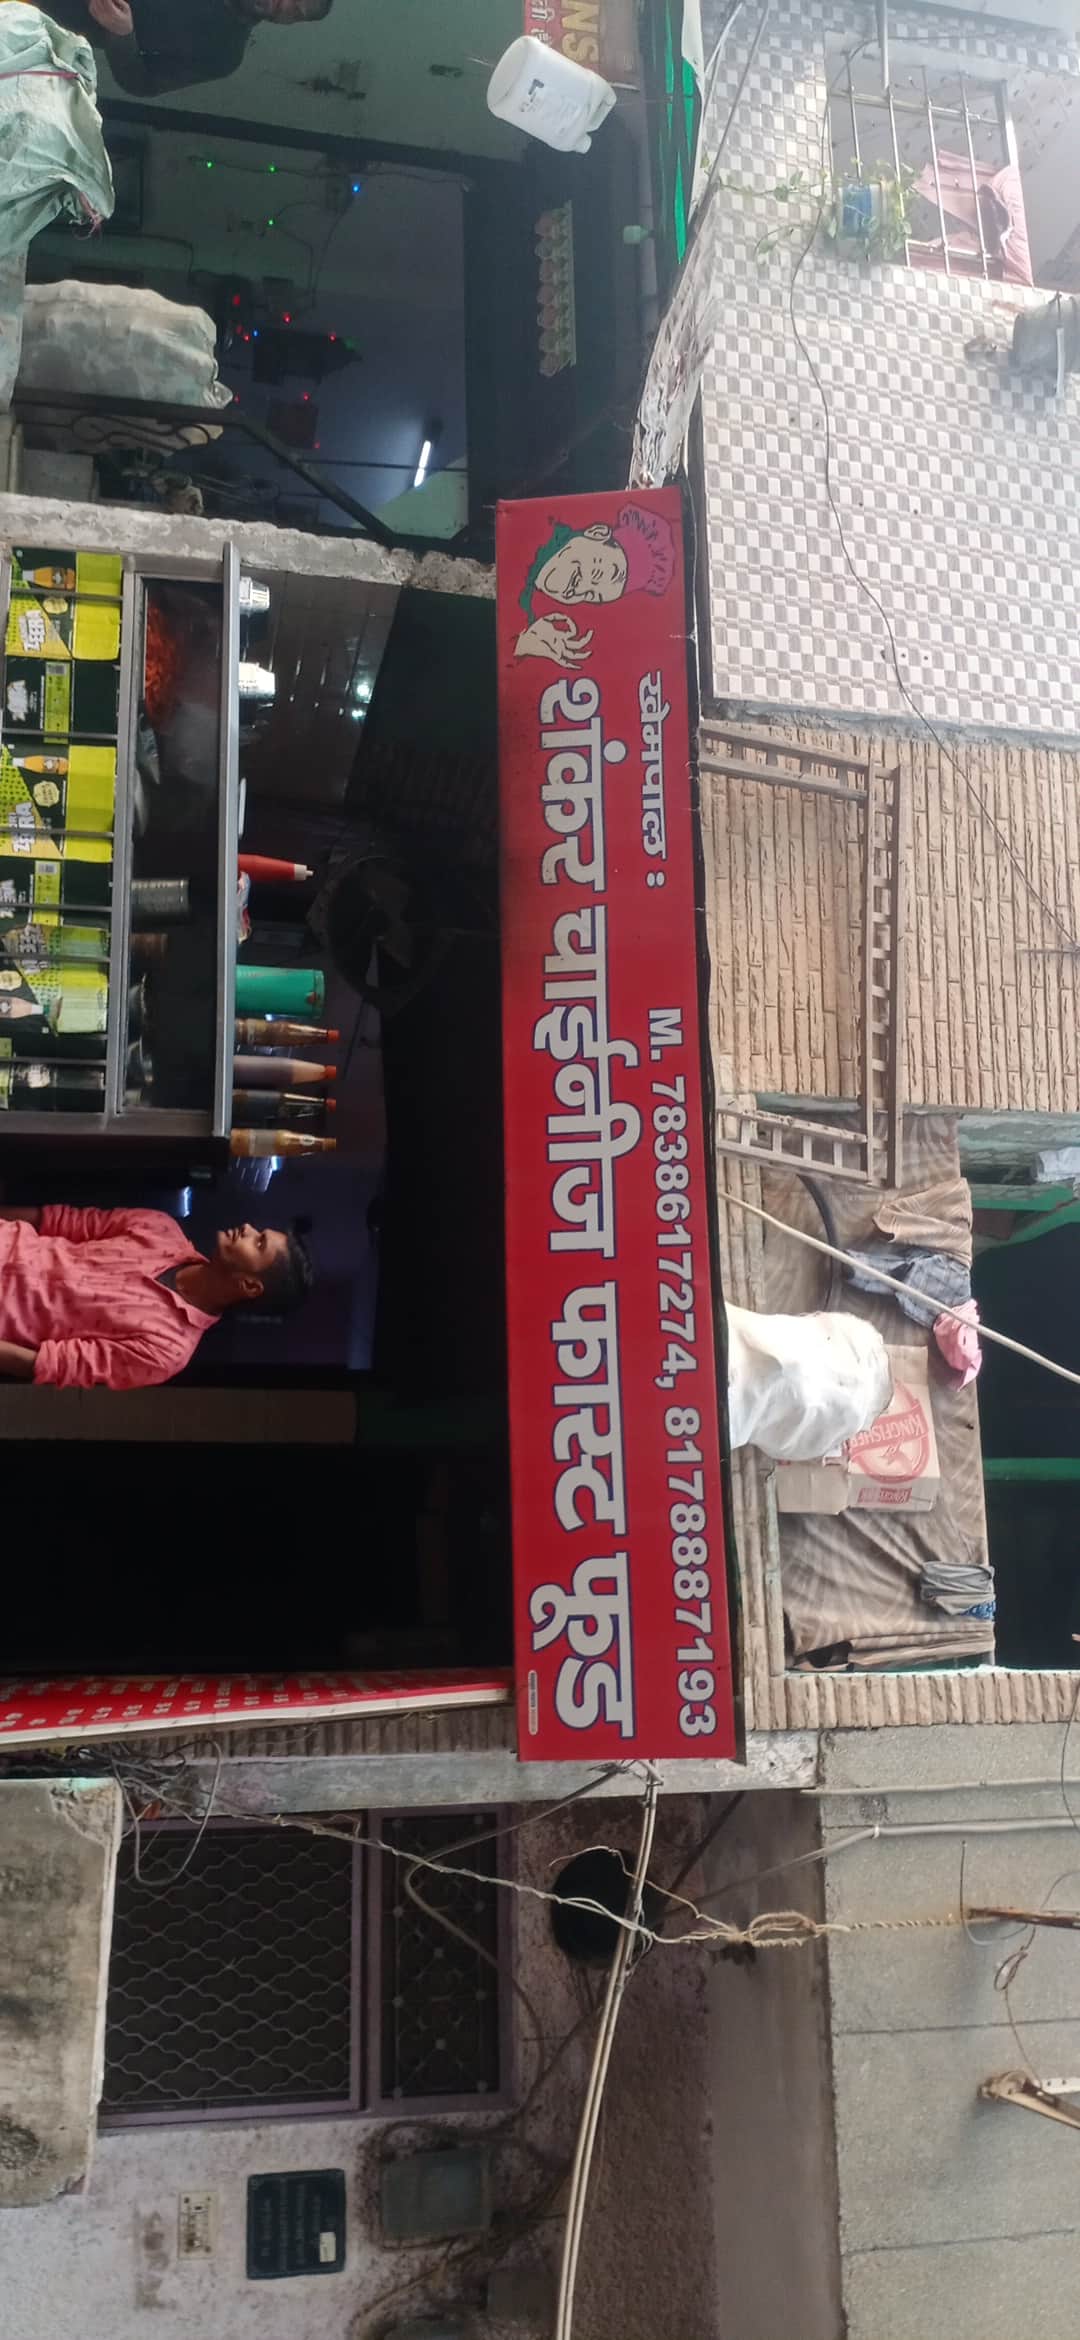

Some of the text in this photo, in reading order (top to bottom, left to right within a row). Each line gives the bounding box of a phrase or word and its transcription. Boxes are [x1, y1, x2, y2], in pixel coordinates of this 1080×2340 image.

[561, 0, 600, 63] NS
[13, 801, 35, 853] ZERA
[638, 671, 672, 860] खेमपाल
[528, 678, 642, 1738] शंकर चाईनीज फास्ट फूड
[649, 1006, 717, 1737] M. 7838617274, 8178887193
